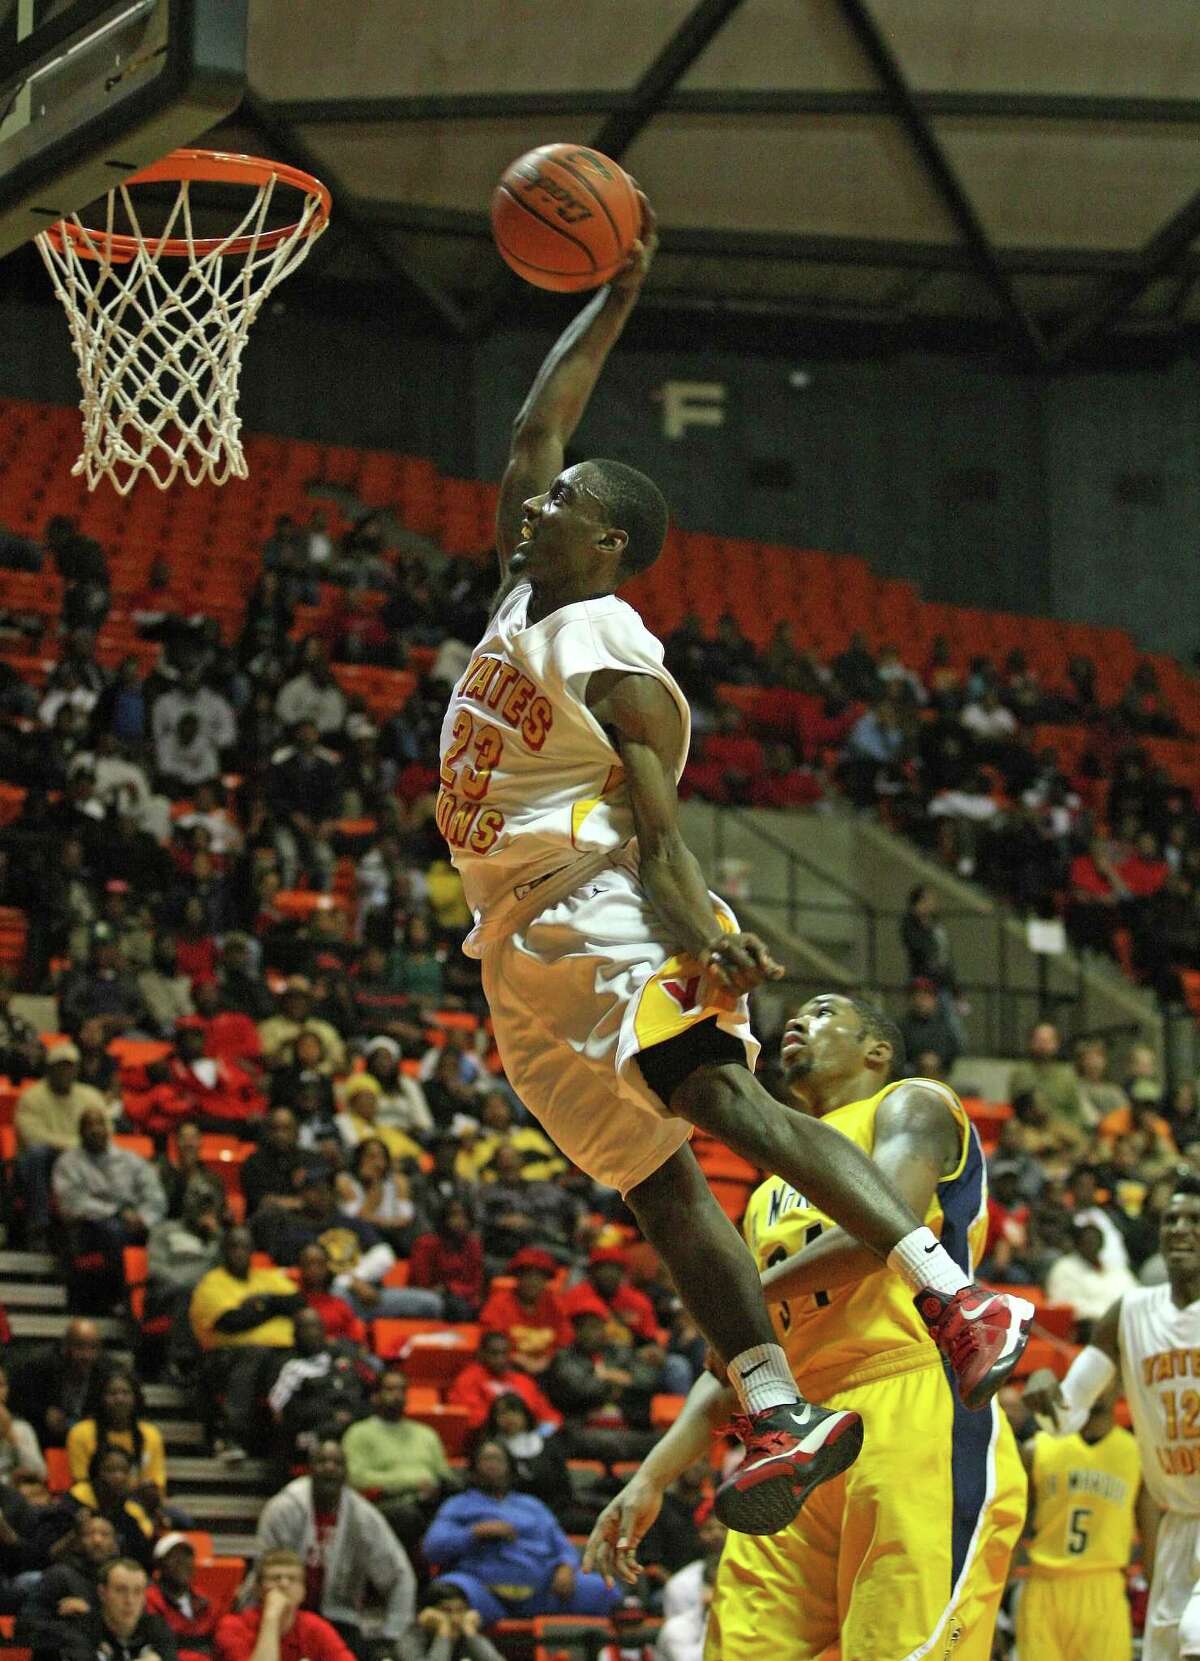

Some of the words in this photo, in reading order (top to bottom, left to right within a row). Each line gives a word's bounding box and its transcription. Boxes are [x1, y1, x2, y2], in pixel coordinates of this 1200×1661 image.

[663, 377, 724, 437] F
[440, 709, 504, 800] 23
[1160, 1388, 1200, 1441] 12
[1068, 1508, 1094, 1555] 5
